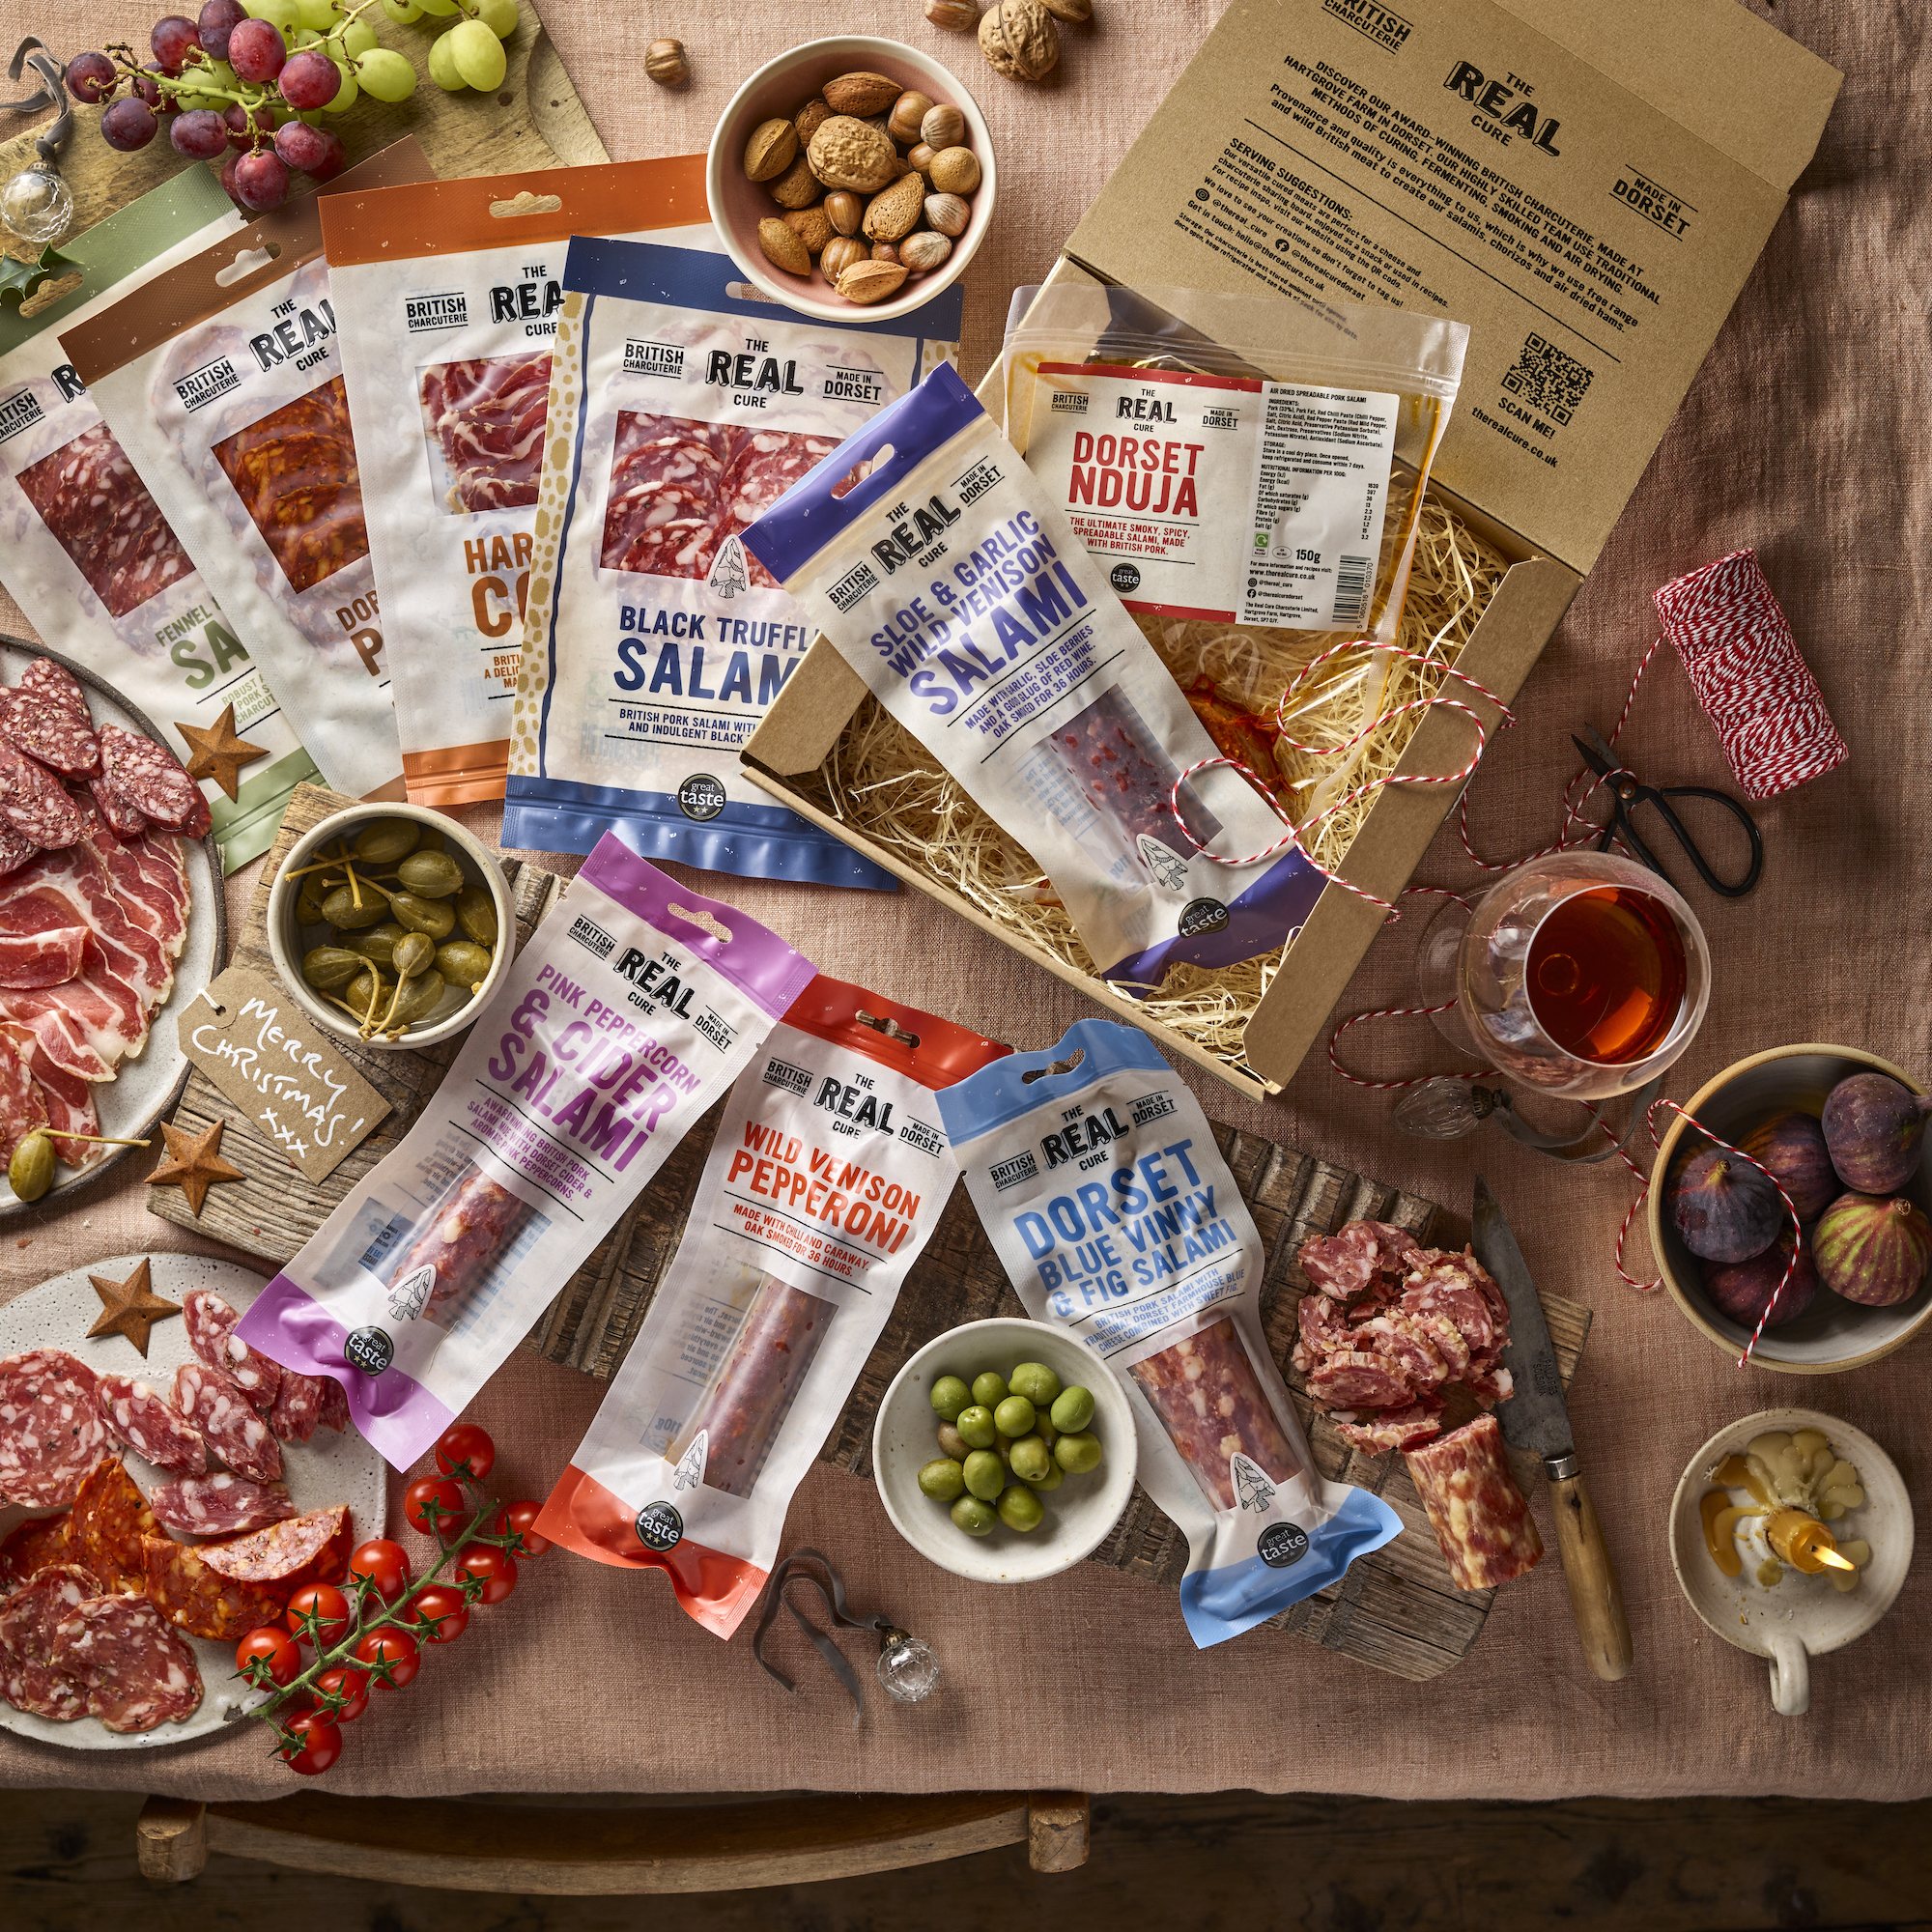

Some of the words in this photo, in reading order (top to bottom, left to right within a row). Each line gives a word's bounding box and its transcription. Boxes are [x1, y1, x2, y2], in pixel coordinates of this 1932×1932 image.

[1506, 71, 1535, 98] THE
[1443, 60, 1560, 157] REAL
[1269, 83, 1329, 126] Provenance
[1329, 123, 1350, 139] and
[1347, 136, 1386, 164] quality
[1386, 156, 1398, 169] is
[1399, 167, 1453, 206] everything
[1470, 115, 1513, 147] CURE
[1230, 137, 1276, 173] SERVING
[1276, 167, 1353, 221] SUGGESTIONS:
[1284, 55, 1348, 99] HARTGROVE
[1346, 95, 1378, 120] FARM
[1377, 115, 1391, 128] IN
[1436, 153, 1460, 172] OUR
[1459, 167, 1498, 196] HIGHLY
[1498, 192, 1541, 224] SKILLED
[1543, 220, 1573, 245] TEAM
[1573, 241, 1595, 260] USE
[1595, 255, 1661, 305] TRADITIONAL
[1316, 61, 1368, 99] DISCOVER
[1369, 95, 1391, 114] OUR
[1480, 166, 1524, 199] BRITISH
[1523, 194, 1597, 248] CHARCUTERIE,
[1597, 242, 1628, 268] MADE
[1627, 264, 1644, 277] AT
[1311, 87, 1362, 124] METHODS
[1362, 120, 1378, 132] OF
[1378, 130, 1419, 163] CURING,
[1421, 157, 1488, 208] FERMENTING,
[1491, 203, 1540, 239] SMOKING
[1539, 235, 1563, 253] AND
[1563, 250, 1583, 268] AIR
[1582, 262, 1623, 296] DRYING.
[1613, 179, 1690, 235] DORSET
[1634, 179, 1666, 204] MADE
[1668, 196, 1682, 213] IN
[1187, 199, 1203, 213] Get
[1202, 209, 1210, 218] in
[1211, 214, 1235, 234] touch:
[522, 265, 547, 278] THE
[406, 297, 467, 318] BRITISH
[409, 313, 468, 328] CHARCUTERIE
[525, 322, 557, 336] CURE
[296, 347, 329, 372] CURE
[625, 343, 684, 365] BRITISH
[745, 338, 769, 353] THE
[176, 360, 235, 399] BRITISH
[623, 358, 682, 375] CHARCUTERIE
[705, 350, 804, 396] REAL
[836, 371, 861, 383] MADE
[863, 375, 871, 384] IN
[184, 374, 240, 410] CHARCUTERIE
[733, 394, 767, 409] CURE
[824, 380, 882, 401] DORSET
[1052, 394, 1089, 405] BRITISH
[1295, 390, 1329, 399] SPREADABLE
[1051, 402, 1087, 412] CHARCUTERIE
[1116, 396, 1178, 423] REAL
[1203, 414, 1238, 429] DORSET
[1498, 397, 1533, 425] SCAN
[1532, 418, 1556, 440] ME!
[1133, 423, 1154, 433] CURE
[1472, 407, 1557, 468] therealcure.co.uk
[1073, 431, 1205, 476] DORSET
[959, 466, 1003, 504] DORSET
[1068, 465, 1198, 517] NDUJA
[871, 496, 961, 575] REAL
[1070, 517, 1085, 526] THE
[1087, 519, 1127, 531] ULTIMATE
[1129, 524, 1160, 536] SMOKY,
[1163, 527, 1190, 539] SPICY,
[1073, 526, 1124, 540] SPREADABLE
[1126, 533, 1159, 545] SALAMI,
[1162, 537, 1185, 547] MADE
[918, 541, 949, 568] CURE
[1087, 537, 1108, 548] WITH
[1110, 540, 1143, 552] BRITISH
[1145, 545, 1168, 554] PORK.
[1295, 549, 1321, 564] 150g
[828, 565, 872, 605] BRITISH
[837, 574, 878, 611] CHARCUTERIE
[870, 597, 935, 657] SLOE
[930, 581, 957, 606] &
[952, 510, 1039, 588] GARLIC
[1111, 572, 1141, 585] taste
[886, 619, 952, 678] WILD
[950, 534, 1057, 626] VENISON
[155, 604, 213, 647] FENNEL
[619, 606, 706, 640] BLACK
[717, 617, 819, 651] TRUFFL
[909, 562, 1089, 716] SALAMI
[1059, 625, 1094, 656] BERRIES
[1066, 658, 1097, 684] HOURS.
[238, 690, 261, 710] PORK
[652, 724, 707, 740] INDULGENT
[680, 789, 722, 807] taste
[691, 781, 716, 793] great
[574, 917, 616, 952] BRITISH
[1180, 905, 1228, 937] taste
[613, 947, 696, 1020] REAL
[627, 992, 657, 1016] CURE
[536, 963, 587, 1009] PINK
[584, 998, 701, 1096] PEPPERCORN
[695, 1015, 732, 1051] DORSET
[552, 1020, 677, 1133] CIDER
[763, 1071, 808, 1095] CHARCUTERIE
[767, 1061, 812, 1088] BRITISH
[488, 1033, 650, 1173] SALAMI
[813, 1076, 895, 1137] REAL
[1132, 1099, 1176, 1124] DORSET
[832, 1121, 862, 1140] CURE
[899, 1126, 945, 1154] DORSET
[1040, 1107, 1130, 1170] REAL
[743, 1121, 804, 1164] WILD
[808, 1148, 922, 1220] VENISON
[990, 1154, 1036, 1182] BRITISH
[995, 1164, 1038, 1189] CHARCUTERIE
[1079, 1151, 1109, 1172] CURE
[519, 1155, 575, 1202] PEPPERCORNS.
[726, 1150, 910, 1255] PEPPERONI
[1013, 1139, 1201, 1260] DORSET
[1037, 1235, 1122, 1292] BLUE
[1121, 1185, 1218, 1253] VINNY
[824, 1243, 870, 1271] CARAWAY.
[1080, 1269, 1128, 1305] FIG
[1132, 1219, 1237, 1286] SALAMI
[348, 1332, 387, 1370] taste
[639, 1512, 679, 1544] taste
[1262, 1534, 1307, 1561] taste
